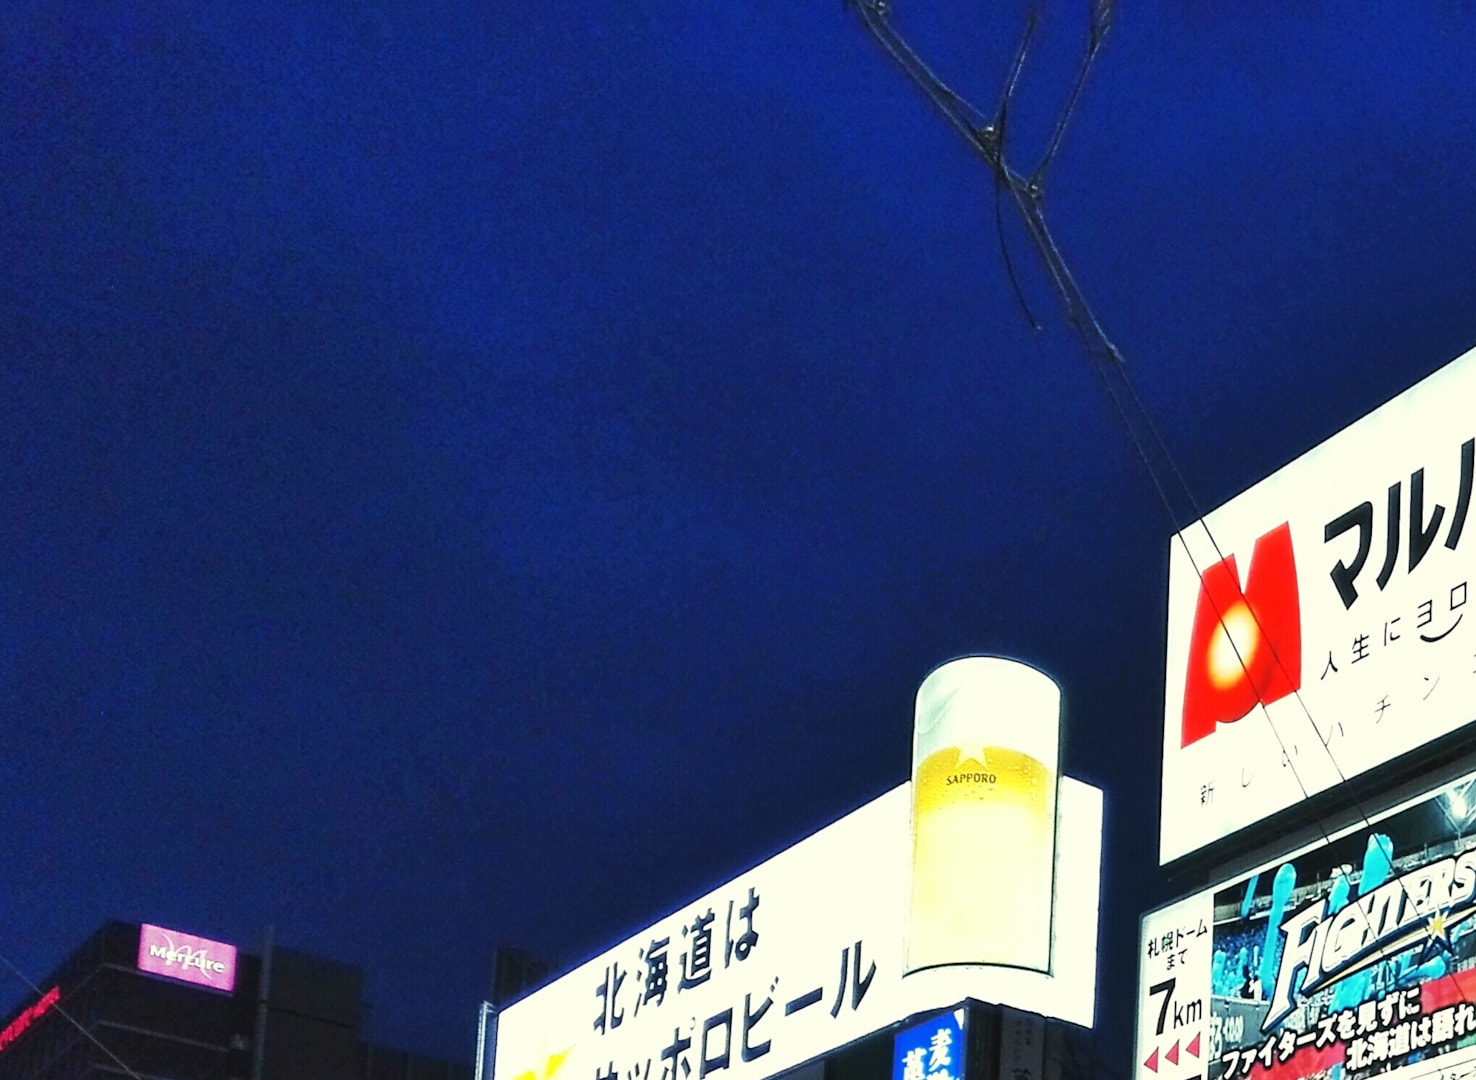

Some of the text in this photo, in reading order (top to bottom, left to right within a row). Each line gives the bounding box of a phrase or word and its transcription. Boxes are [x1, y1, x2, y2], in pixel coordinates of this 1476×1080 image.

[946, 773, 997, 786] SAPPORO
[1147, 919, 1208, 959] 札幌ドーム
[150, 943, 225, 973] Mercure
[592, 886, 760, 1036] 北海道は
[1167, 949, 1188, 971] まで
[1222, 987, 1421, 1080] ファイターズを見ずに
